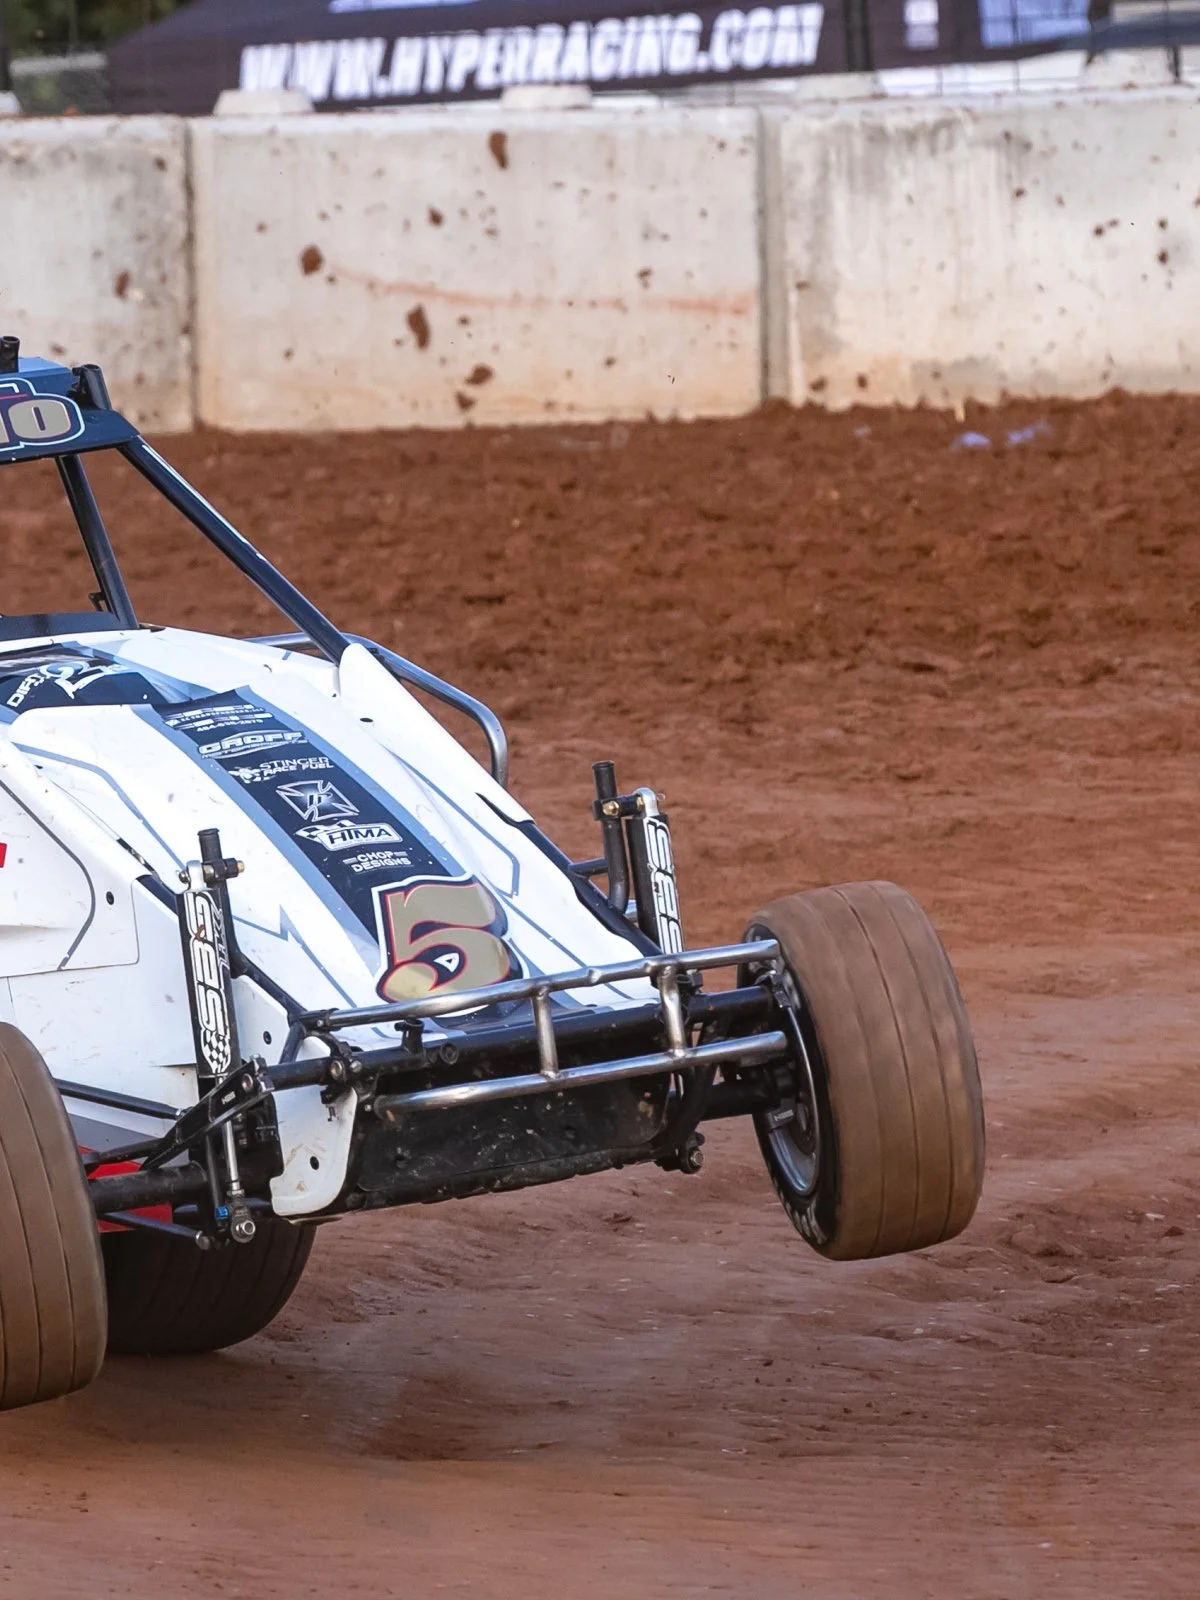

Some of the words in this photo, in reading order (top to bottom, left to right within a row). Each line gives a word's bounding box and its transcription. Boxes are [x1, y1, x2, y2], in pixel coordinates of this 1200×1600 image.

[241, 3, 824, 99] WWW.HYPERRACING.COM
[259, 756, 329, 769] STINGER
[262, 764, 297, 776] RACE
[301, 762, 334, 772] FUEL
[357, 851, 394, 862] CHOP
[351, 857, 412, 873] DESIGNS
[376, 879, 516, 1005] 5
